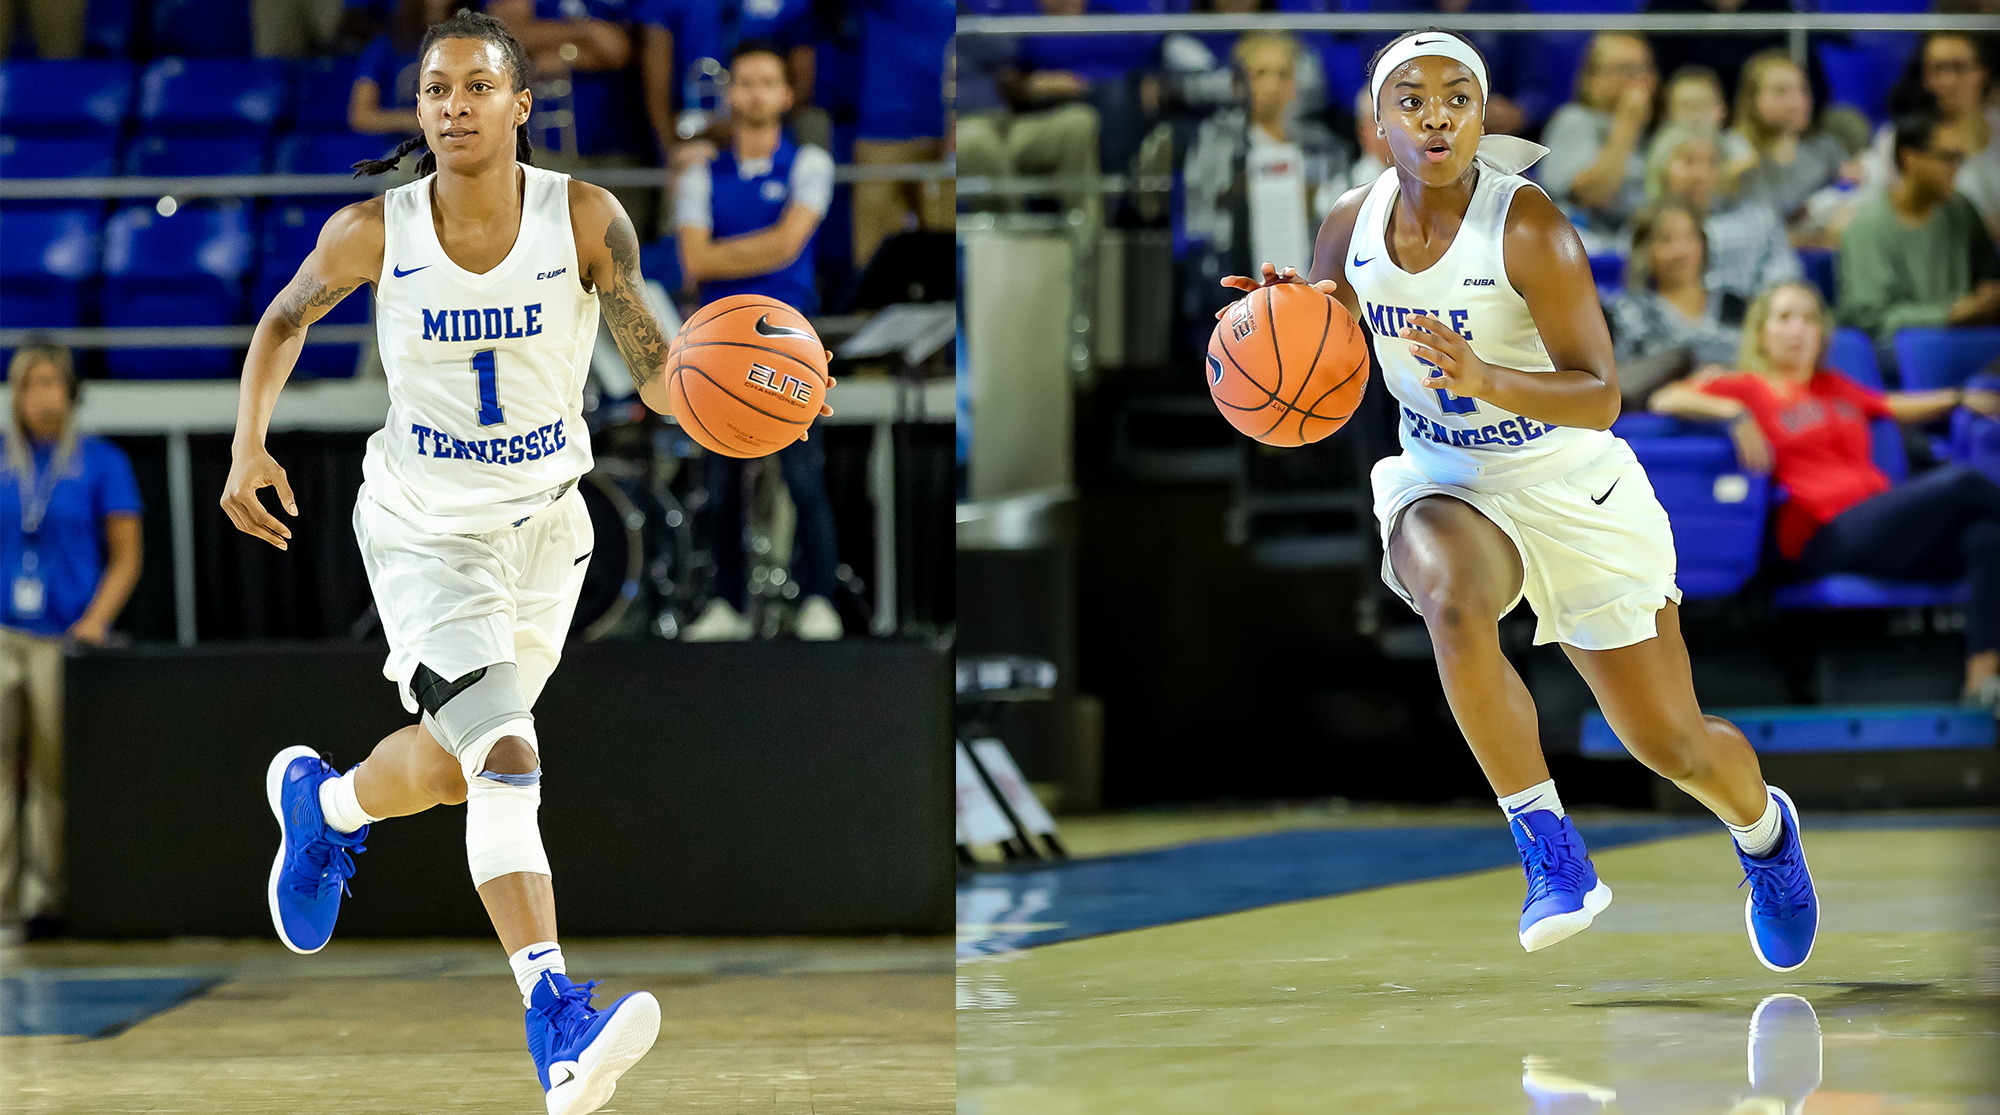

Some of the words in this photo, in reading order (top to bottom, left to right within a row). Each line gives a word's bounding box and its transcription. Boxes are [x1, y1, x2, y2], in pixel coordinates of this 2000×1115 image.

[421, 302, 544, 342] MIDDLE
[1366, 300, 1474, 341] MIDE
[468, 346, 507, 428] 1
[744, 381, 807, 409] CHAMPIONSHIP
[746, 362, 814, 405] ELITE
[411, 415, 567, 466] TENNESSEE
[1402, 406, 1560, 447] TENNESSE
